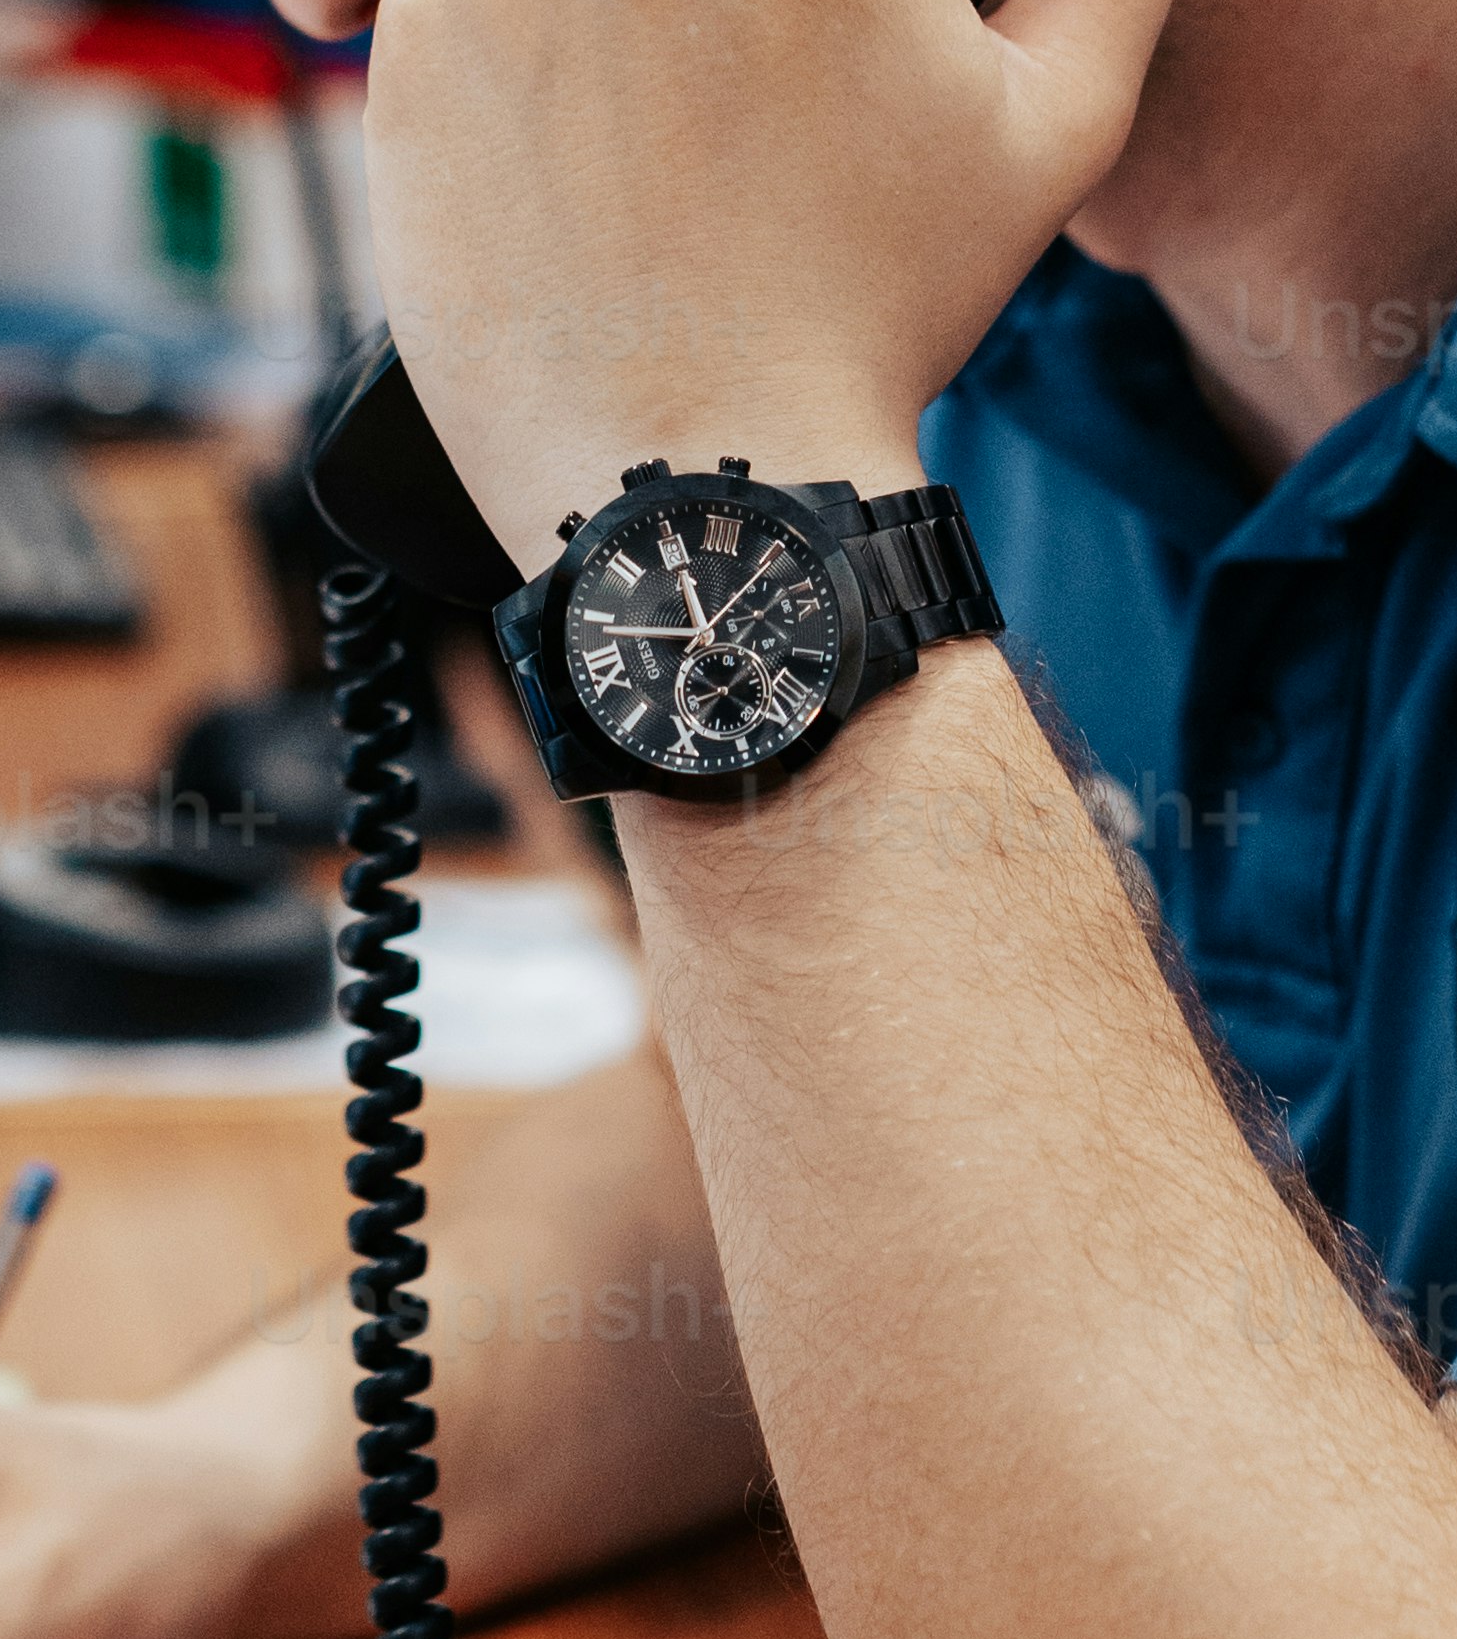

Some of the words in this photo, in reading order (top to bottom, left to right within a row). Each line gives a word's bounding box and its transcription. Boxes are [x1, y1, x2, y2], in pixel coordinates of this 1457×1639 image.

[664, 542, 681, 564] 26
[761, 637, 776, 650] 45
[635, 635, 661, 681] GUES
[722, 654, 736, 667] 10
[582, 639, 633, 699] XII
[740, 707, 755, 722] 20
